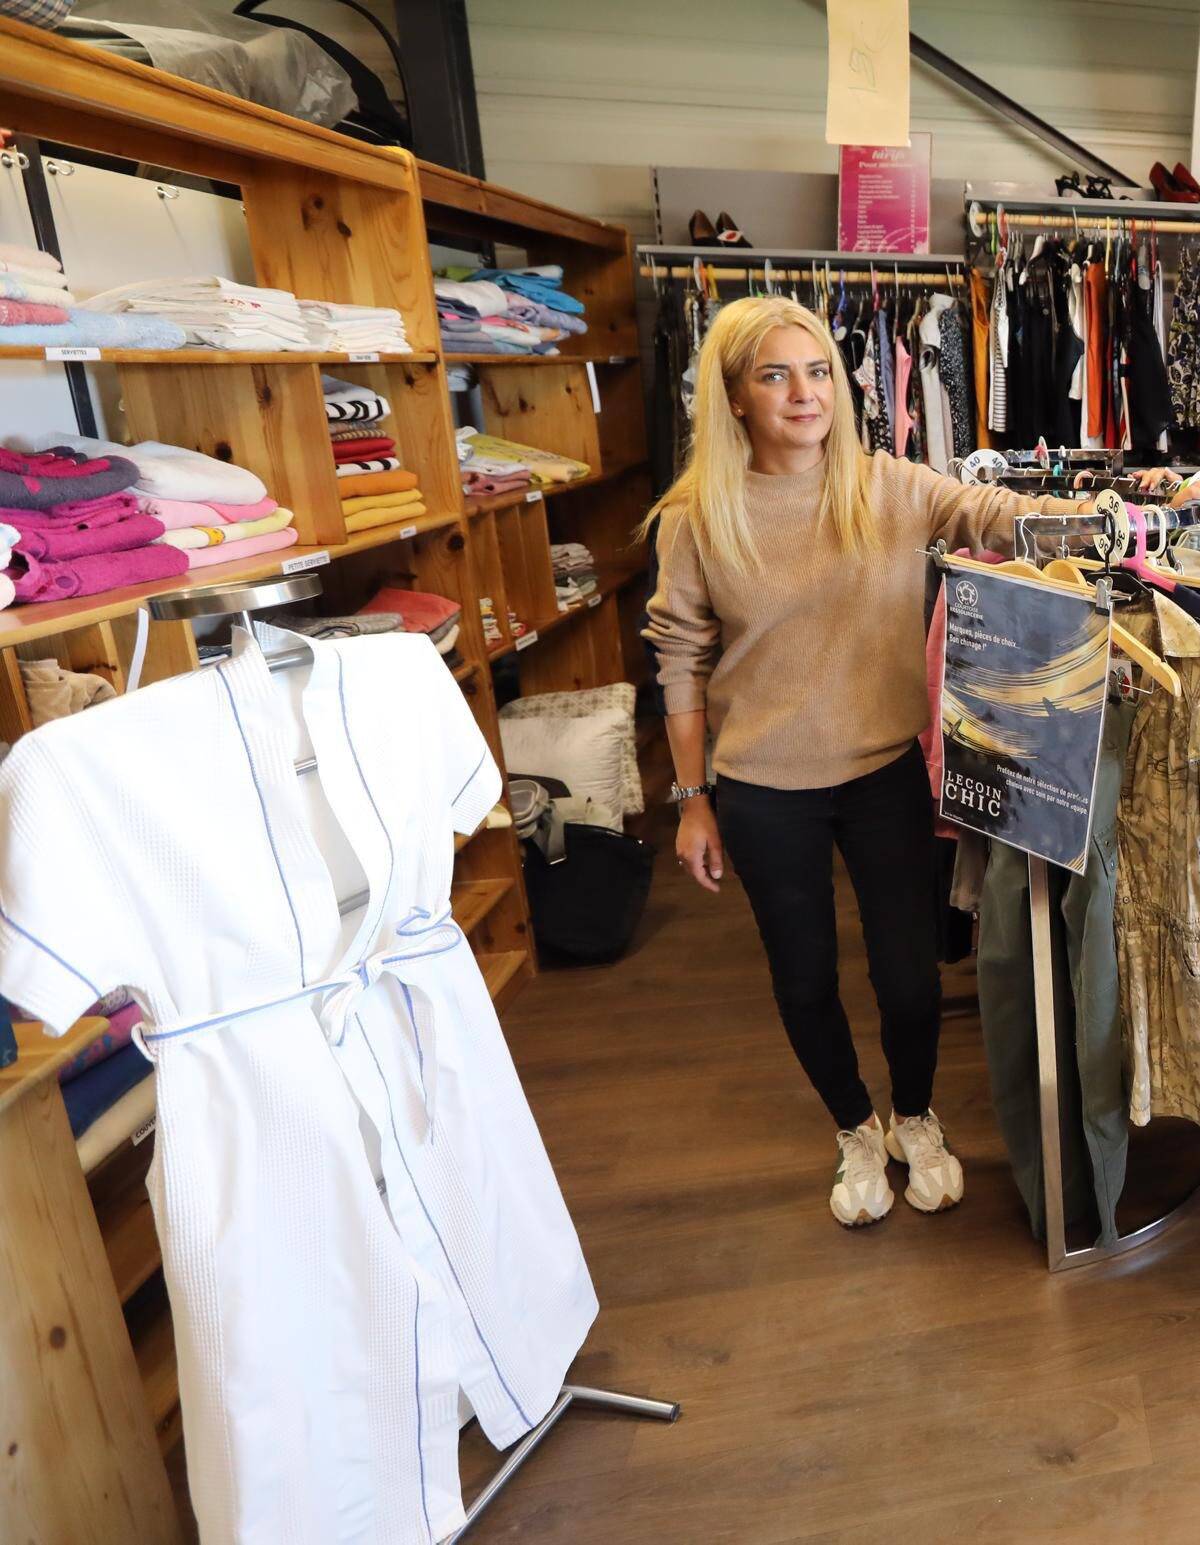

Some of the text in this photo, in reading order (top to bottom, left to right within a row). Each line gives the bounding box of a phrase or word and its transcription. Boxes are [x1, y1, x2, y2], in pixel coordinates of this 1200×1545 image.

[970, 456, 980, 468] 40
[1109, 496, 1119, 513] 36
[1118, 530, 1125, 550] 36
[955, 603, 978, 612] COURTOISE
[949, 634, 959, 643] Bon
[974, 630, 992, 641] pièces
[993, 634, 1000, 643] de
[997, 765, 1015, 777] Profitez
[1023, 776, 1036, 785] notre
[1060, 788, 1067, 796] de
[945, 783, 1000, 817] CHIC
[1023, 785, 1035, 795] avec
[1046, 794, 1055, 802] par
